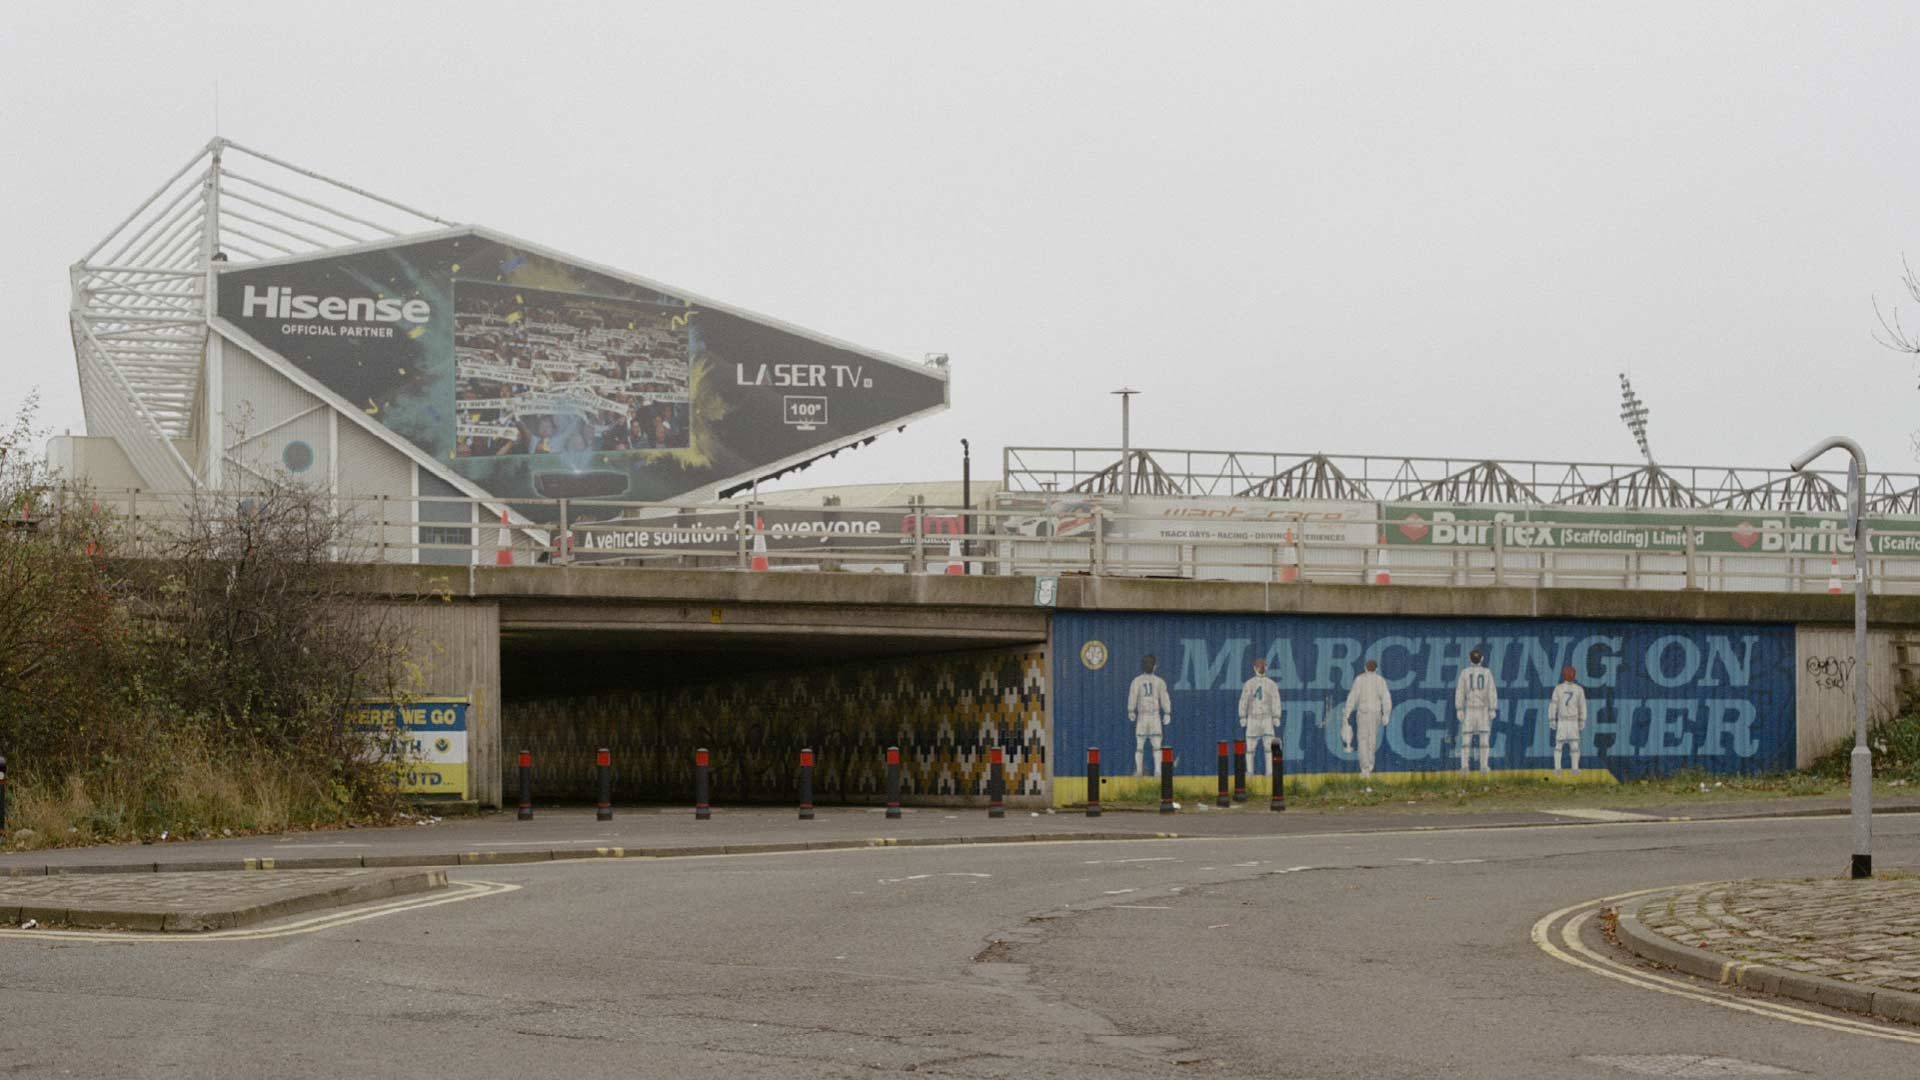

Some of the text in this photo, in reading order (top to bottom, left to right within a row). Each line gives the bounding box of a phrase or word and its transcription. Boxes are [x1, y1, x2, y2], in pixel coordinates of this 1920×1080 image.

[243, 285, 430, 323] Hisense
[282, 324, 393, 338] OFFICIAL PARTNER
[737, 363, 862, 388] LASER TV
[584, 532, 594, 548] A
[597, 530, 649, 549] vehicle
[654, 522, 727, 546] solution
[771, 520, 881, 542] everyone
[1561, 528, 1649, 548] (Scaffolding)
[1653, 531, 1704, 545] Limitd
[1173, 637, 1623, 690] MARCHING
[1645, 634, 1759, 688] ON
[1469, 671, 1485, 691] 10
[1563, 691, 1574, 706] 7
[346, 709, 456, 725] ERE WE GO
